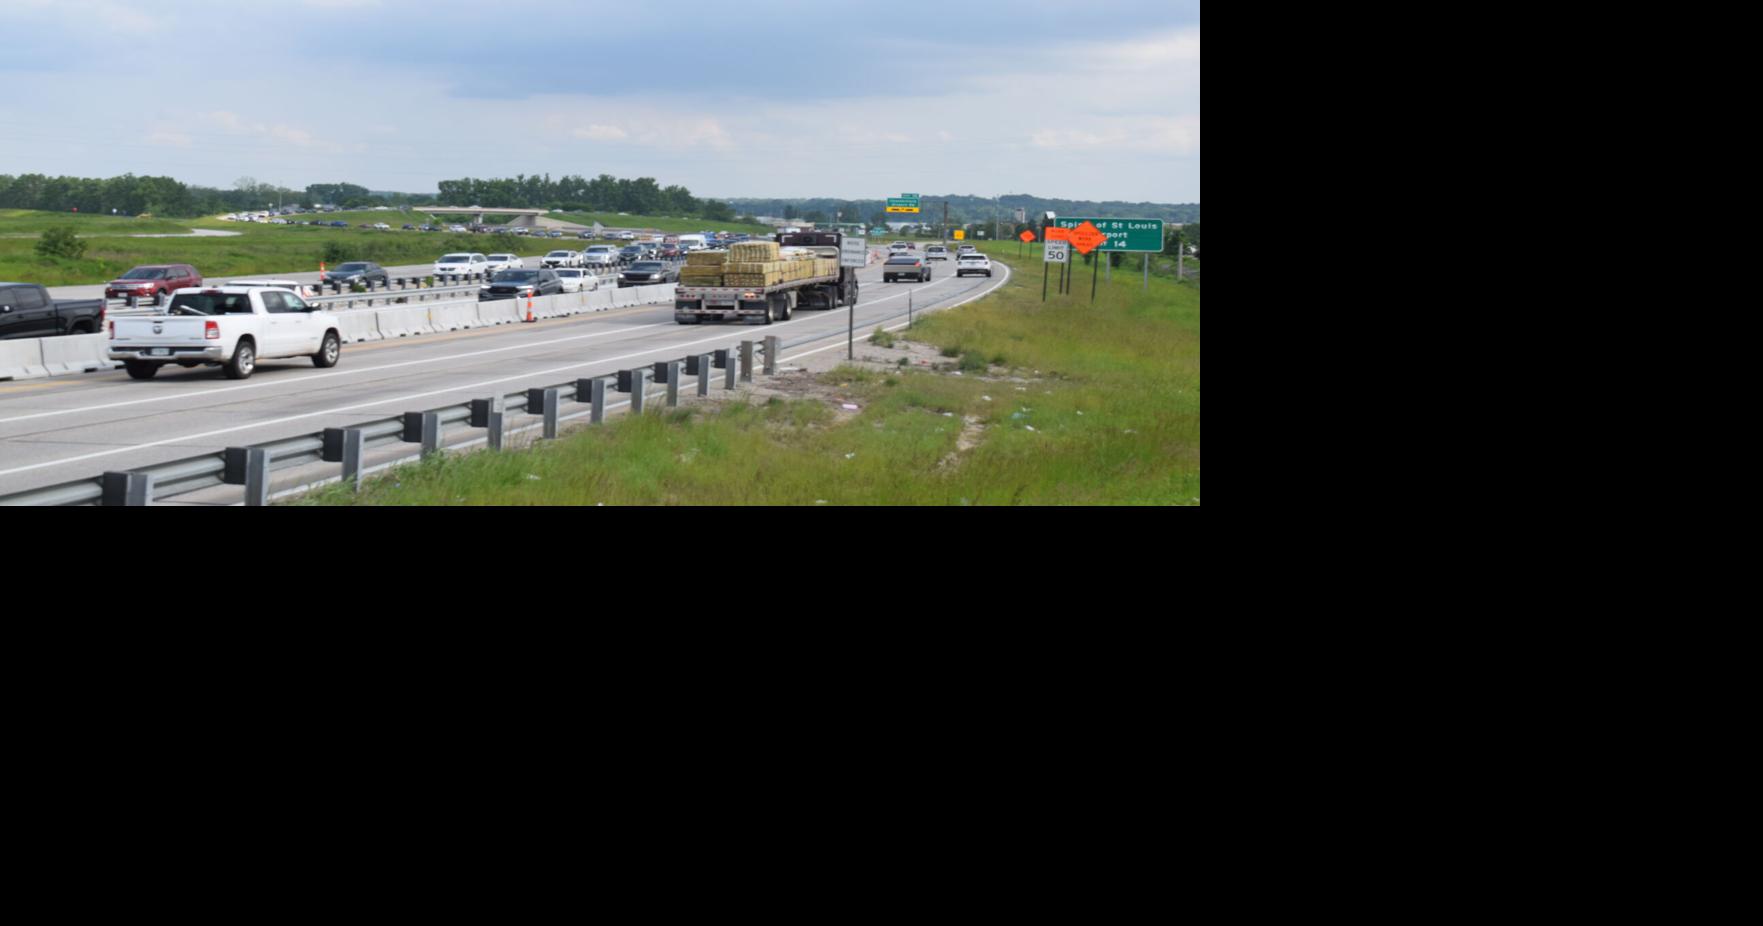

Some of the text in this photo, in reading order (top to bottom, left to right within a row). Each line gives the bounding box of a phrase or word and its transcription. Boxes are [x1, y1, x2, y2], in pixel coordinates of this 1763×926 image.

[1096, 221, 1107, 229] of
[1111, 221, 1123, 229] St
[1128, 221, 1157, 230] Louis
[1048, 250, 1064, 260] 50
